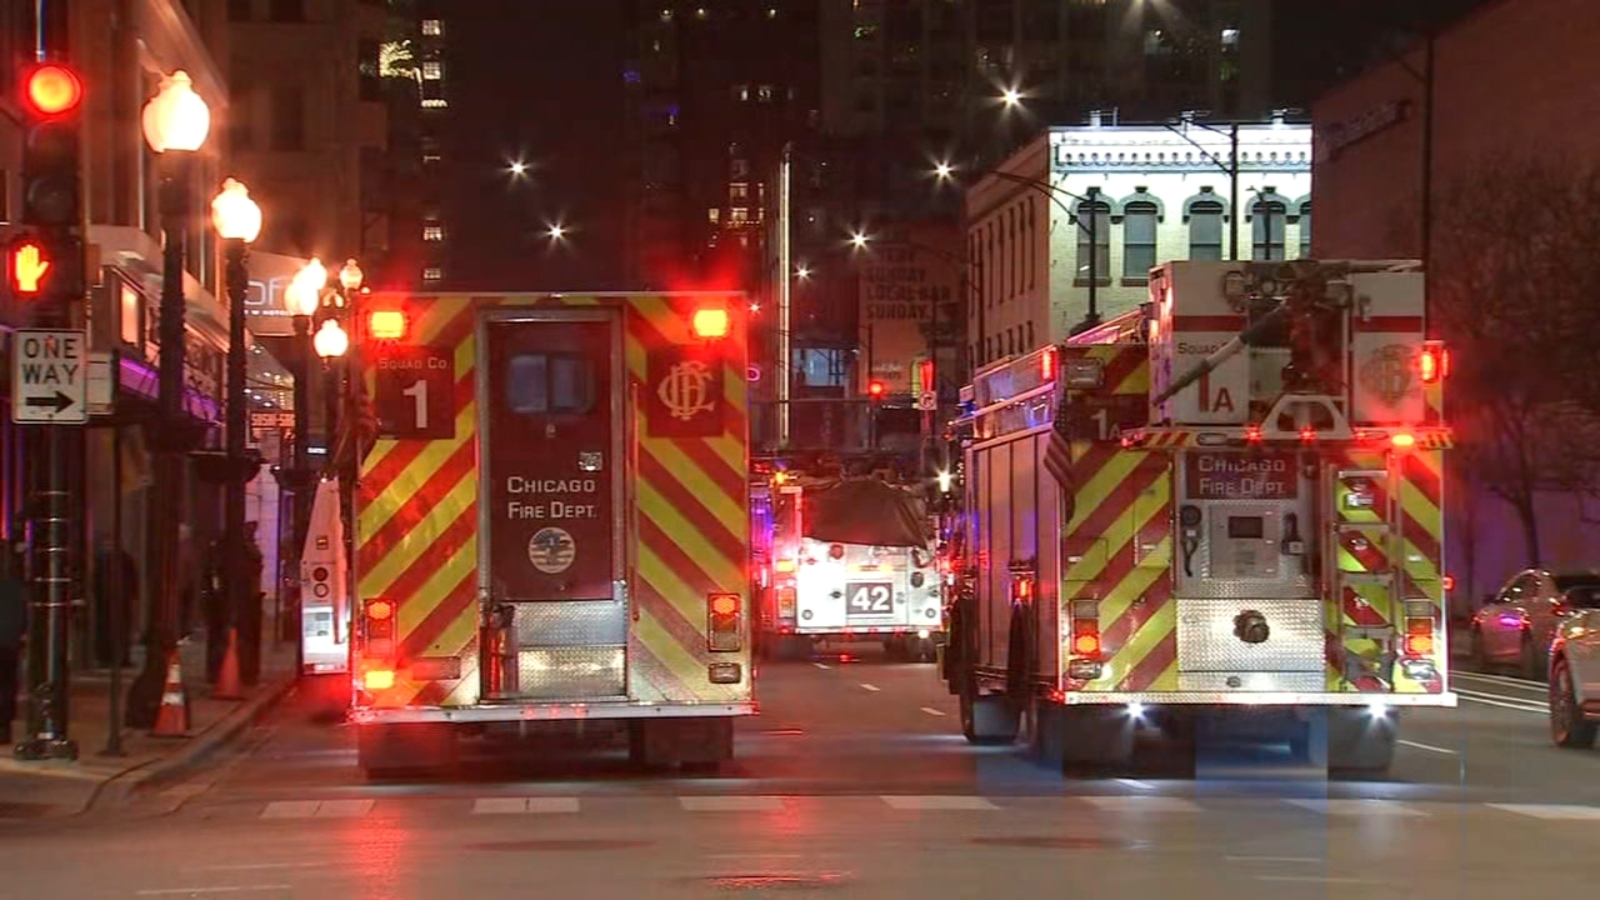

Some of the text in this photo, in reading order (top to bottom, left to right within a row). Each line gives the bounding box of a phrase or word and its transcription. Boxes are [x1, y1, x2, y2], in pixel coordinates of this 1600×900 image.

[24, 338, 78, 359] ONE
[22, 363, 79, 385] WAY
[403, 379, 428, 429] 1
[1198, 455, 1286, 473] CHICAGO
[507, 476, 596, 494] CHICAGO
[1199, 478, 1236, 496] FIRE
[508, 501, 546, 519] FIRE
[851, 585, 891, 611] 42
